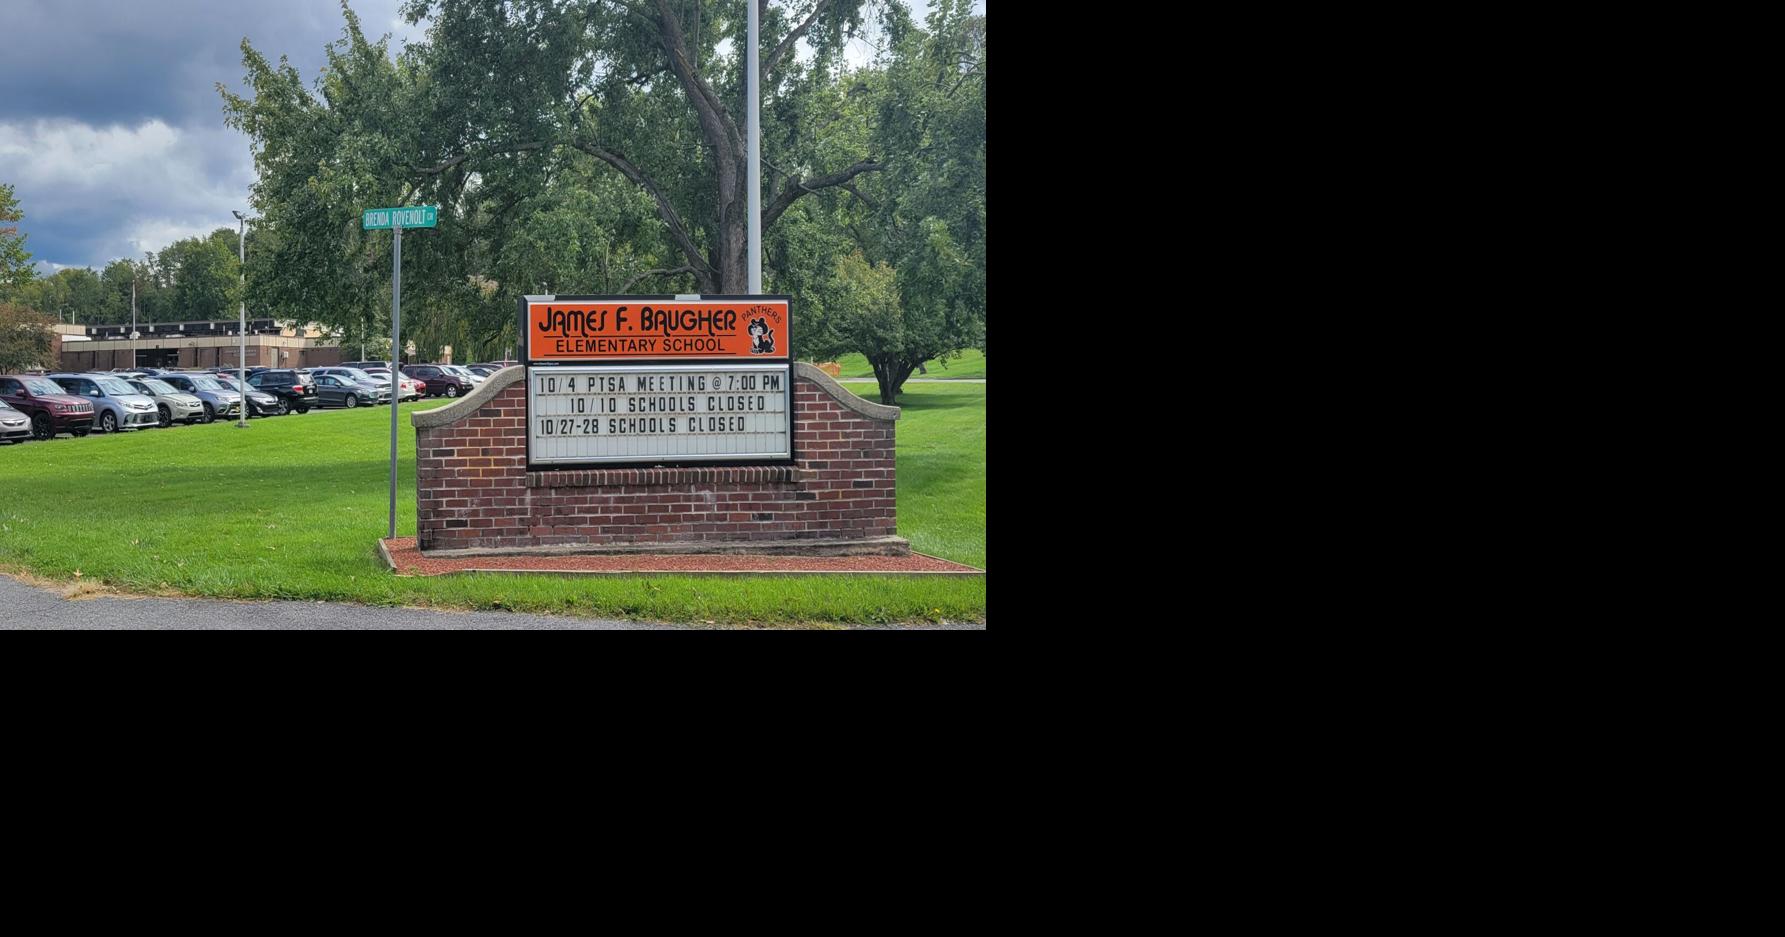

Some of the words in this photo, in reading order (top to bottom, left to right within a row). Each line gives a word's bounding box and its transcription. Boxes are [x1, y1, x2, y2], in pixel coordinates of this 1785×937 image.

[538, 306, 608, 338] JAMES
[616, 306, 633, 332] F.
[640, 306, 737, 337] BAUGHER
[741, 305, 782, 324] PANTHERS
[556, 339, 657, 353] ELEMENTARY
[662, 338, 726, 352] SCHOOL
[540, 377, 576, 393] 10/4
[588, 376, 626, 392] PTSA
[637, 375, 705, 392] MEETING
[728, 375, 756, 390] 7:00
[763, 375, 780, 390] PM
[570, 397, 617, 413] 10/10
[628, 396, 696, 412] SCHOOLS
[707, 395, 765, 411] CLOSED
[541, 418, 600, 435] 10/27-28
[608, 416, 676, 434] SCHOOLS
[688, 415, 745, 433] CLOSED
